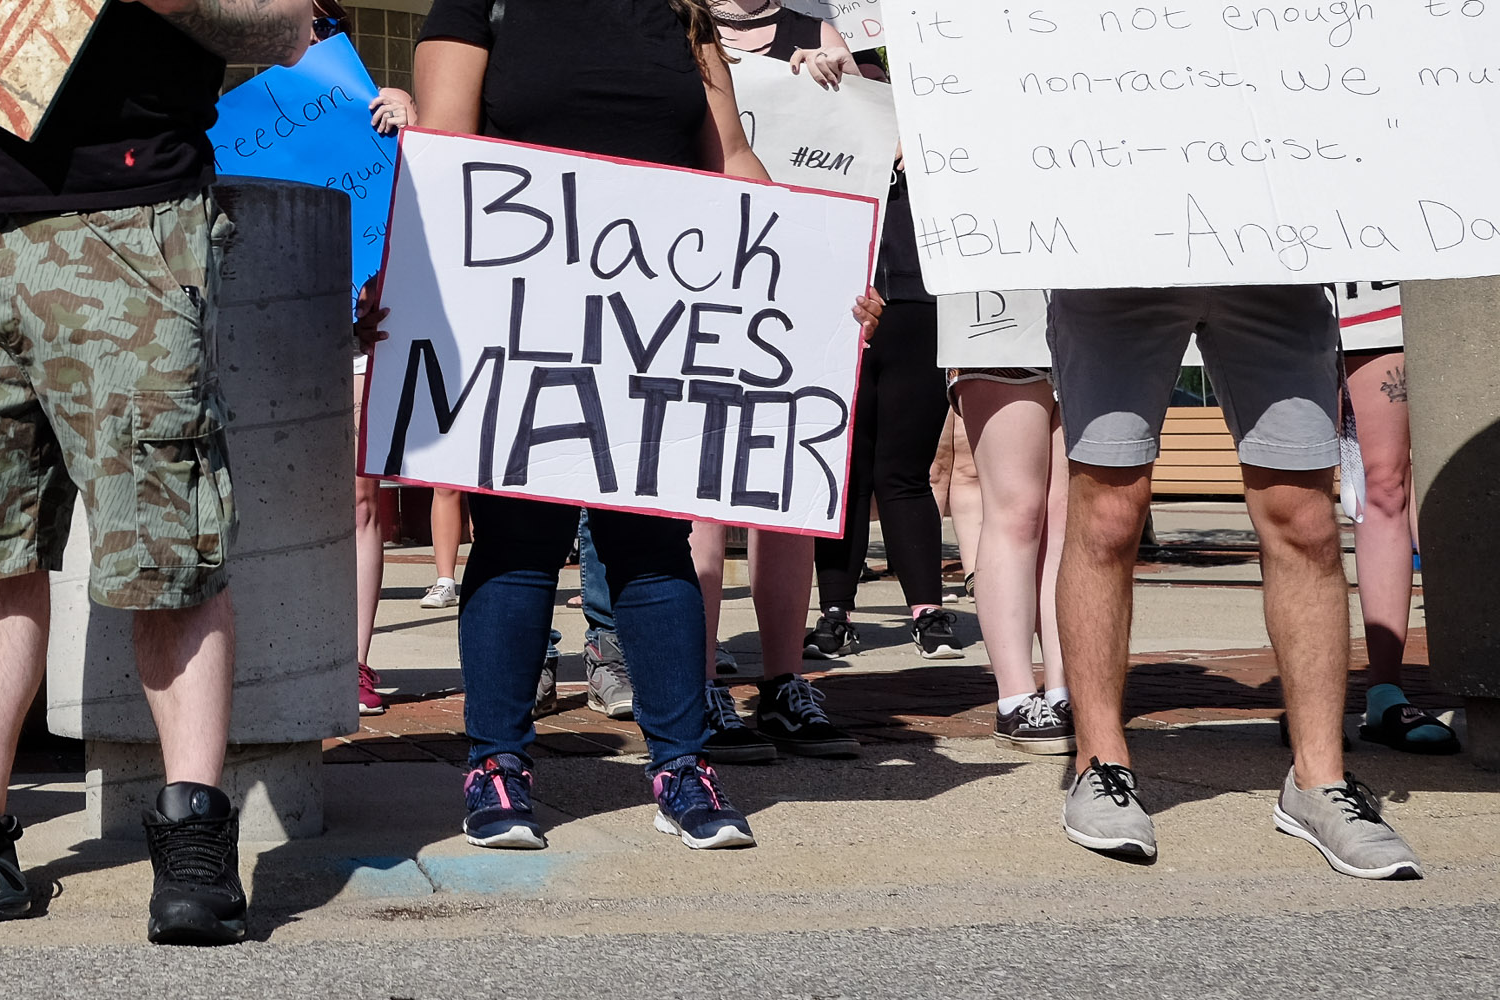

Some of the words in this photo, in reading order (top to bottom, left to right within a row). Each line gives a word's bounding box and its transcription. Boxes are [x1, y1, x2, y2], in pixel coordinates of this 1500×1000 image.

[911, 10, 963, 42] it
[1004, 9, 1059, 34] is
[1100, 4, 1193, 32] not
[909, 62, 973, 97] be
[1019, 66, 1257, 95] non-racist,
[1418, 67, 1500, 87] mu
[211, 81, 354, 172] reedom
[789, 146, 855, 176] #BLM
[919, 132, 979, 176] be
[462, 161, 782, 302] Black
[917, 212, 1079, 260] #BLM
[1417, 200, 1500, 254] Da
[508, 276, 794, 389] LIVES
[384, 338, 849, 520] MATTER
[1401, 706, 1423, 717] NIK
